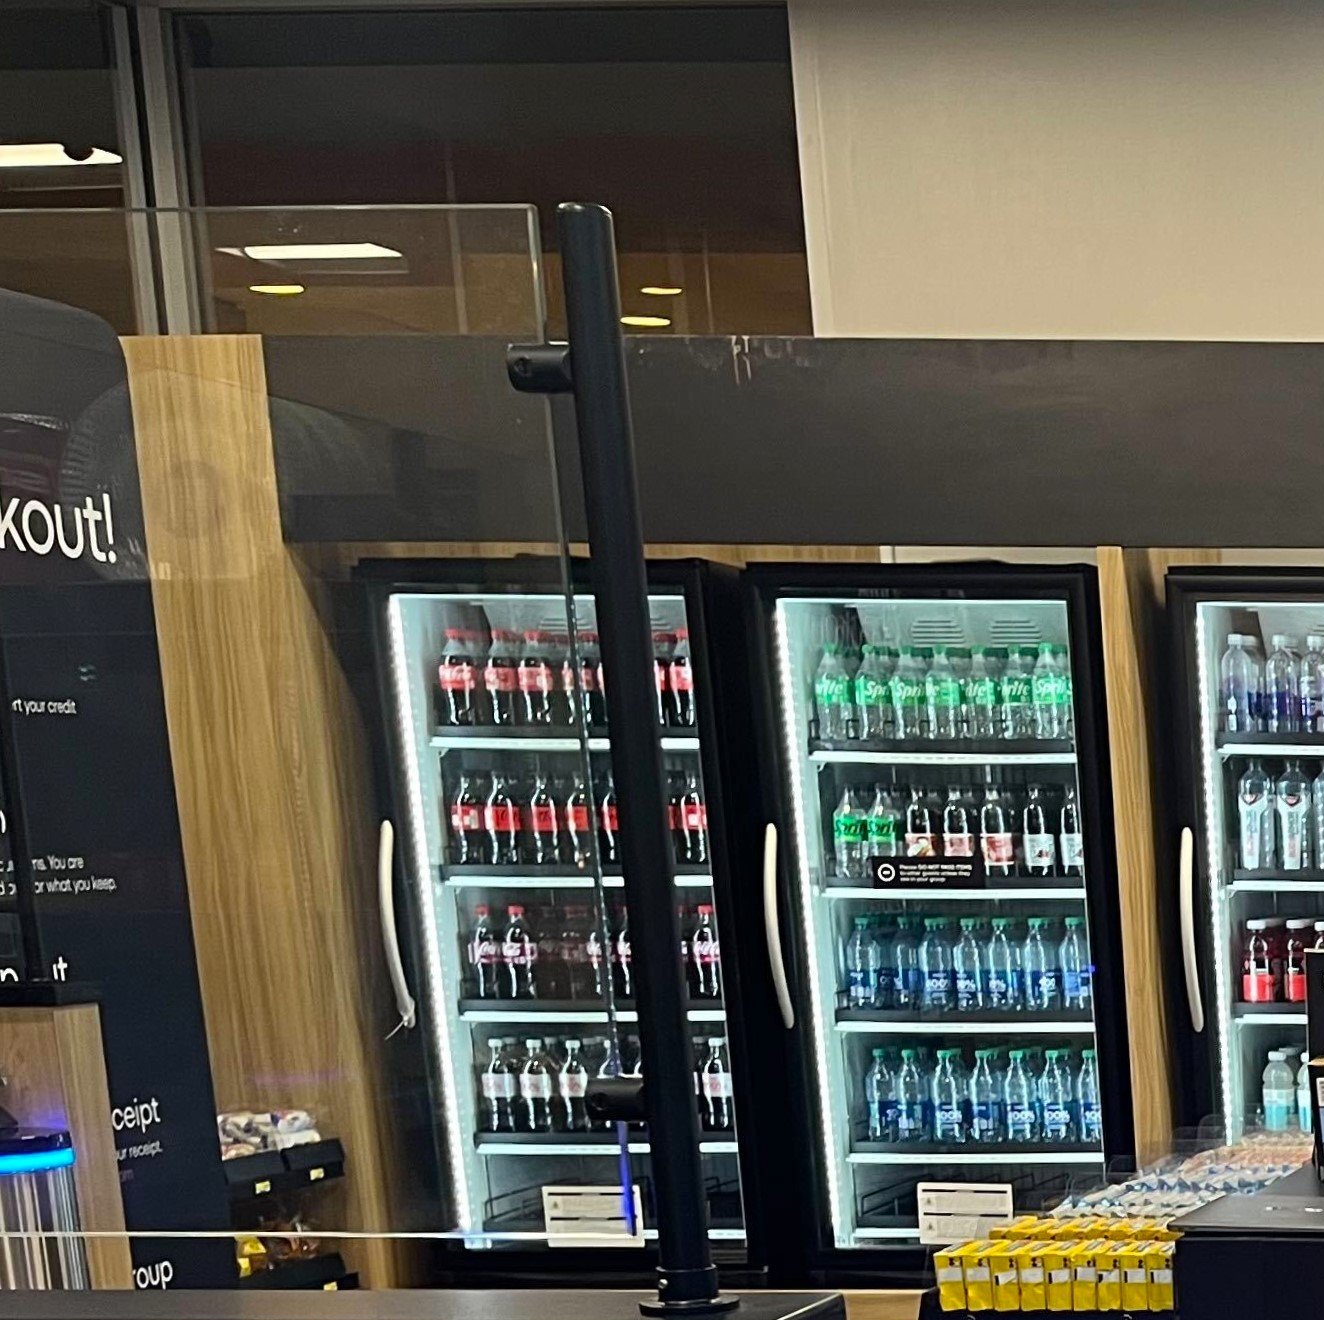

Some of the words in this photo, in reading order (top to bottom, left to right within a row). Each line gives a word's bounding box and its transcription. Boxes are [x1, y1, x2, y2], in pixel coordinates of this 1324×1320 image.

[47, 698, 77, 714] credit
[112, 1098, 161, 1133] ceipt
[133, 1260, 173, 1290] oup
